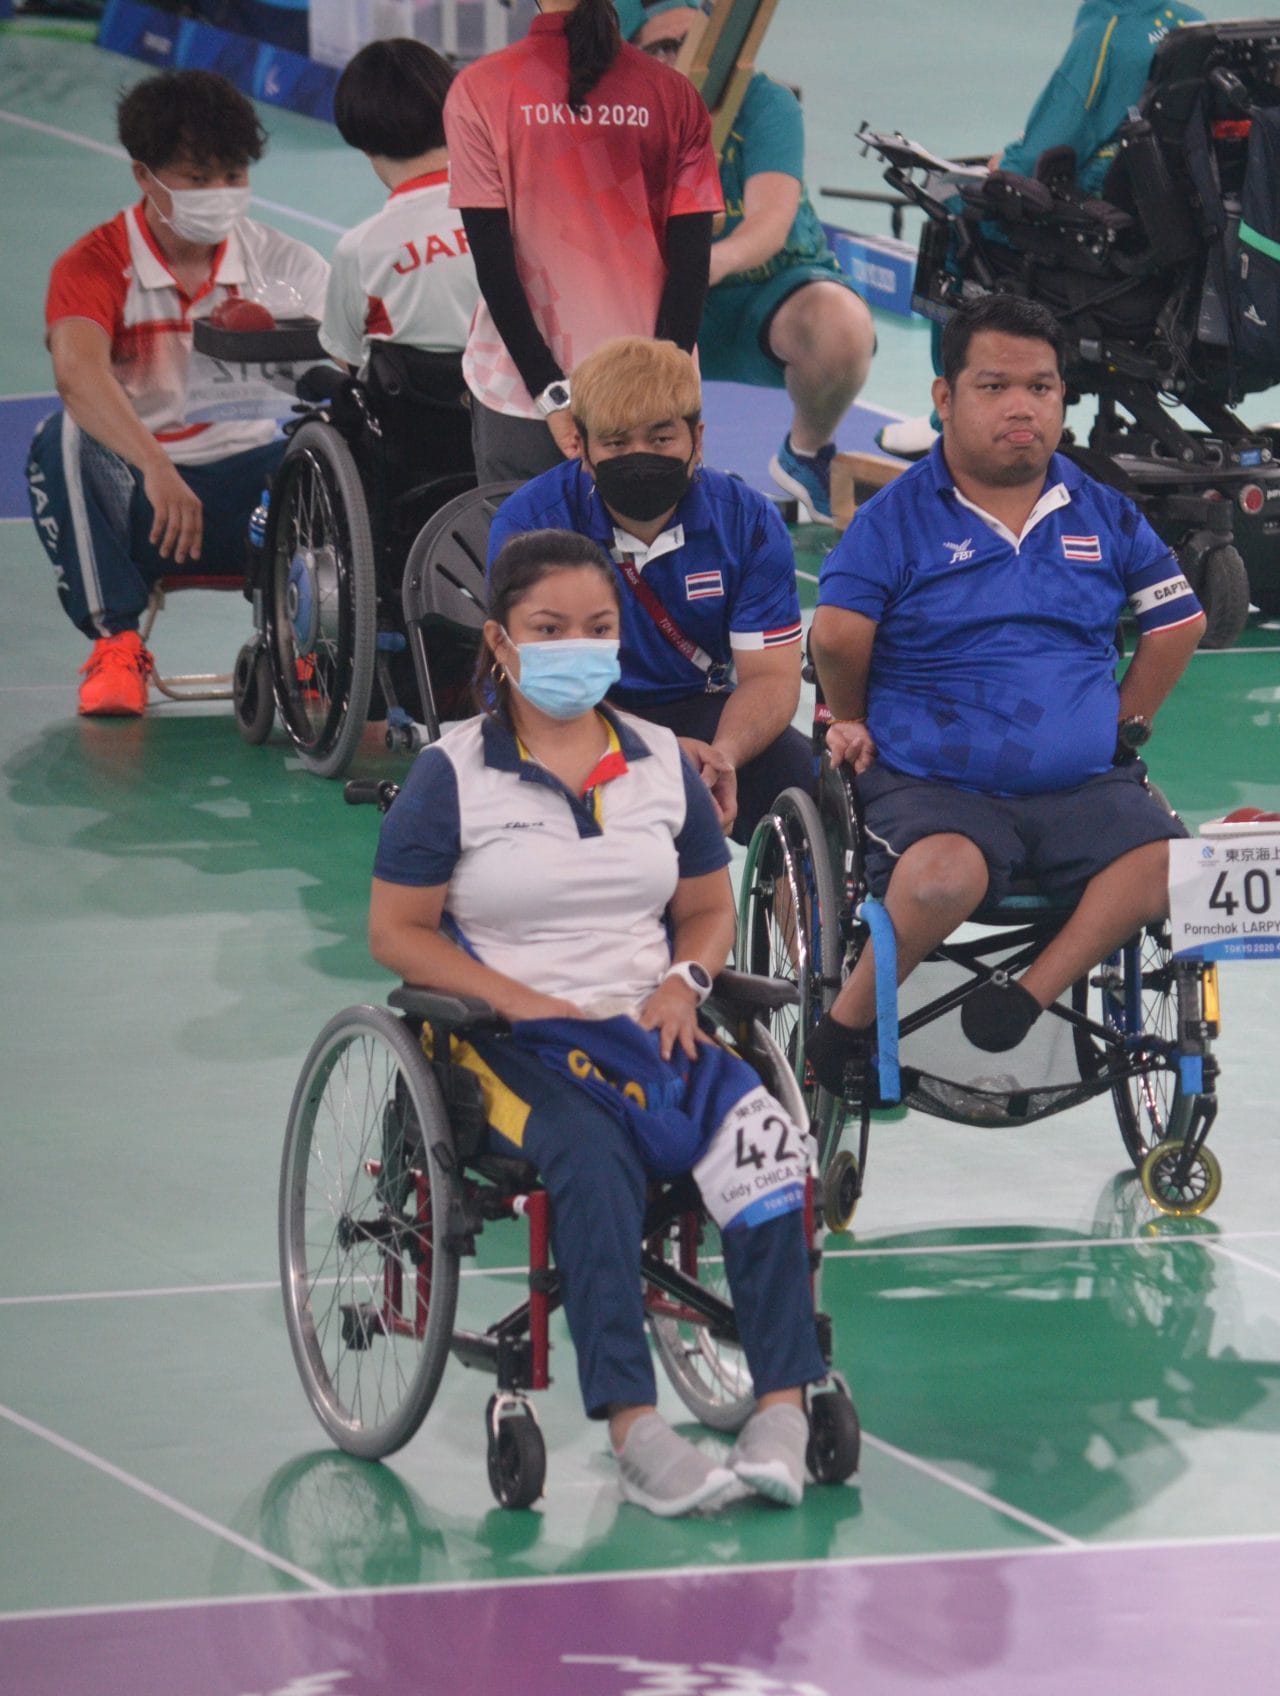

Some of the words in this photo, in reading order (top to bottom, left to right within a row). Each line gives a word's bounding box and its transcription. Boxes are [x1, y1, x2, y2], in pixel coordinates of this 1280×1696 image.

[520, 103, 593, 126] TOKYO
[598, 104, 650, 128] 2020
[949, 549, 977, 564] FBT
[1184, 921, 1239, 936] Pornchok
[1224, 943, 1252, 953] TOKYO
[1253, 943, 1275, 953] 2020
[720, 1182, 753, 1203] Leidy
[754, 1165, 794, 1190] CHICA
